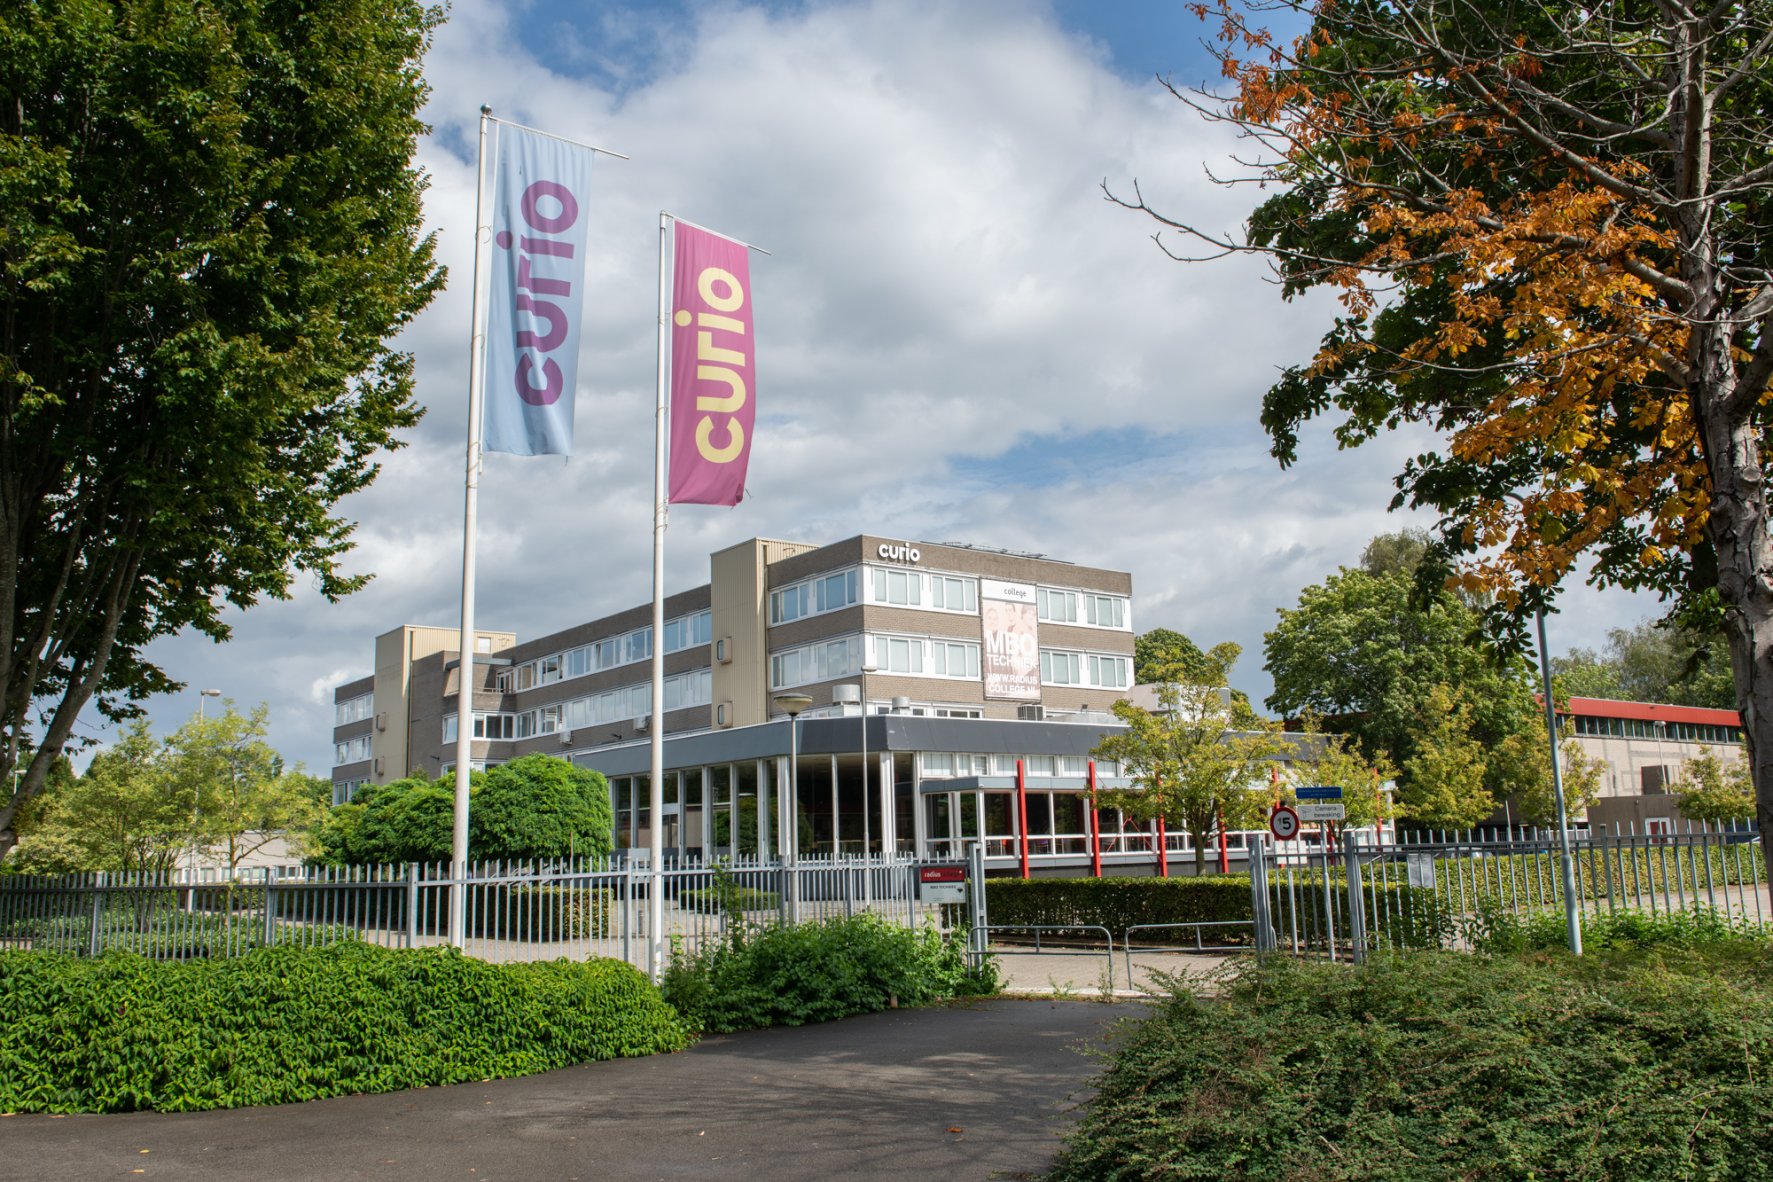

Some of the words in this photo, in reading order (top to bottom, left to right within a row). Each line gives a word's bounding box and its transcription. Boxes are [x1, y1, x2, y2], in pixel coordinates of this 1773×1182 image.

[496, 179, 579, 406] curio
[674, 267, 746, 464] curio
[878, 542, 921, 562] curio
[1003, 587, 1027, 599] college
[986, 631, 1036, 657] MBO
[986, 654, 1037, 669] TECHNIEK
[987, 673, 1038, 685] WWW.RADIUS
[1277, 817, 1291, 830] 15
